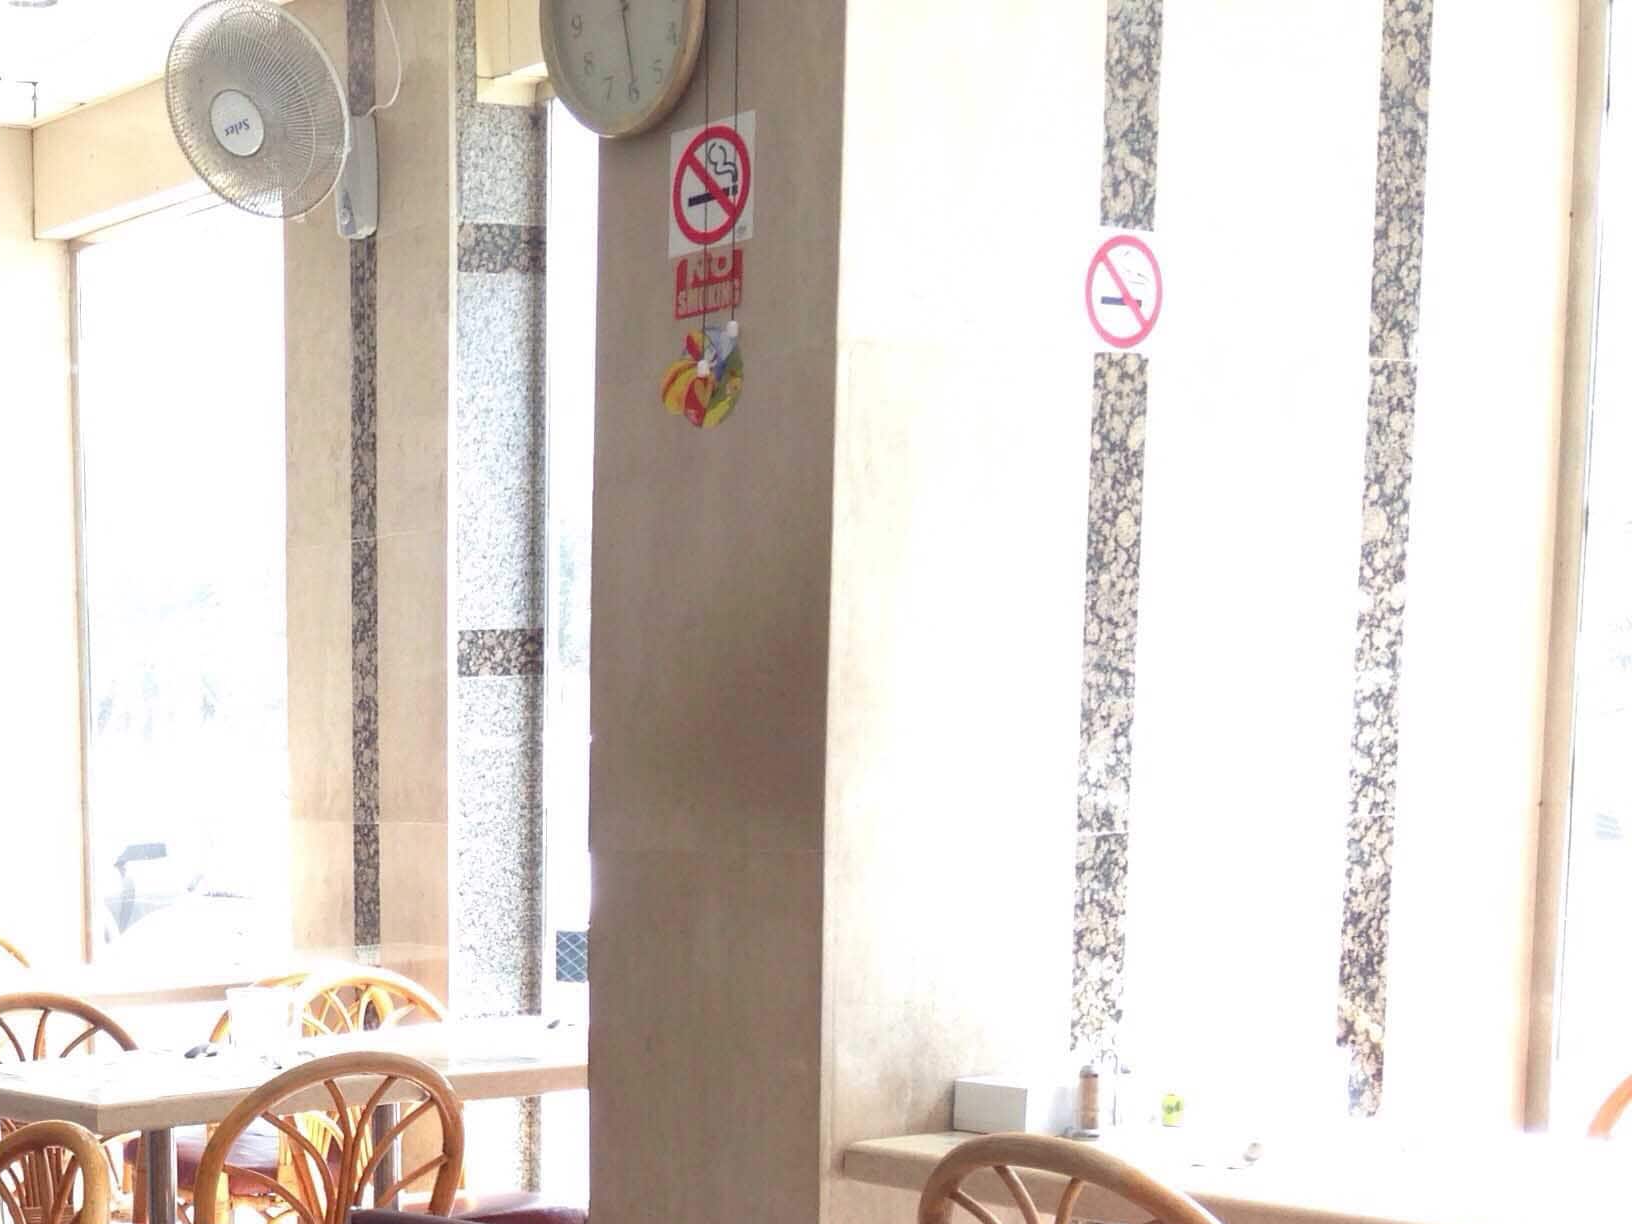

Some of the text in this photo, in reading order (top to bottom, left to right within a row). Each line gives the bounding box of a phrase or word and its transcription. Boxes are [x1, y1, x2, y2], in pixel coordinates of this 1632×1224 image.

[571, 14, 583, 39] 9
[584, 51, 593, 77] 8
[648, 59, 663, 85] 5
[603, 75, 615, 100] 7
[686, 249, 734, 289] NO
